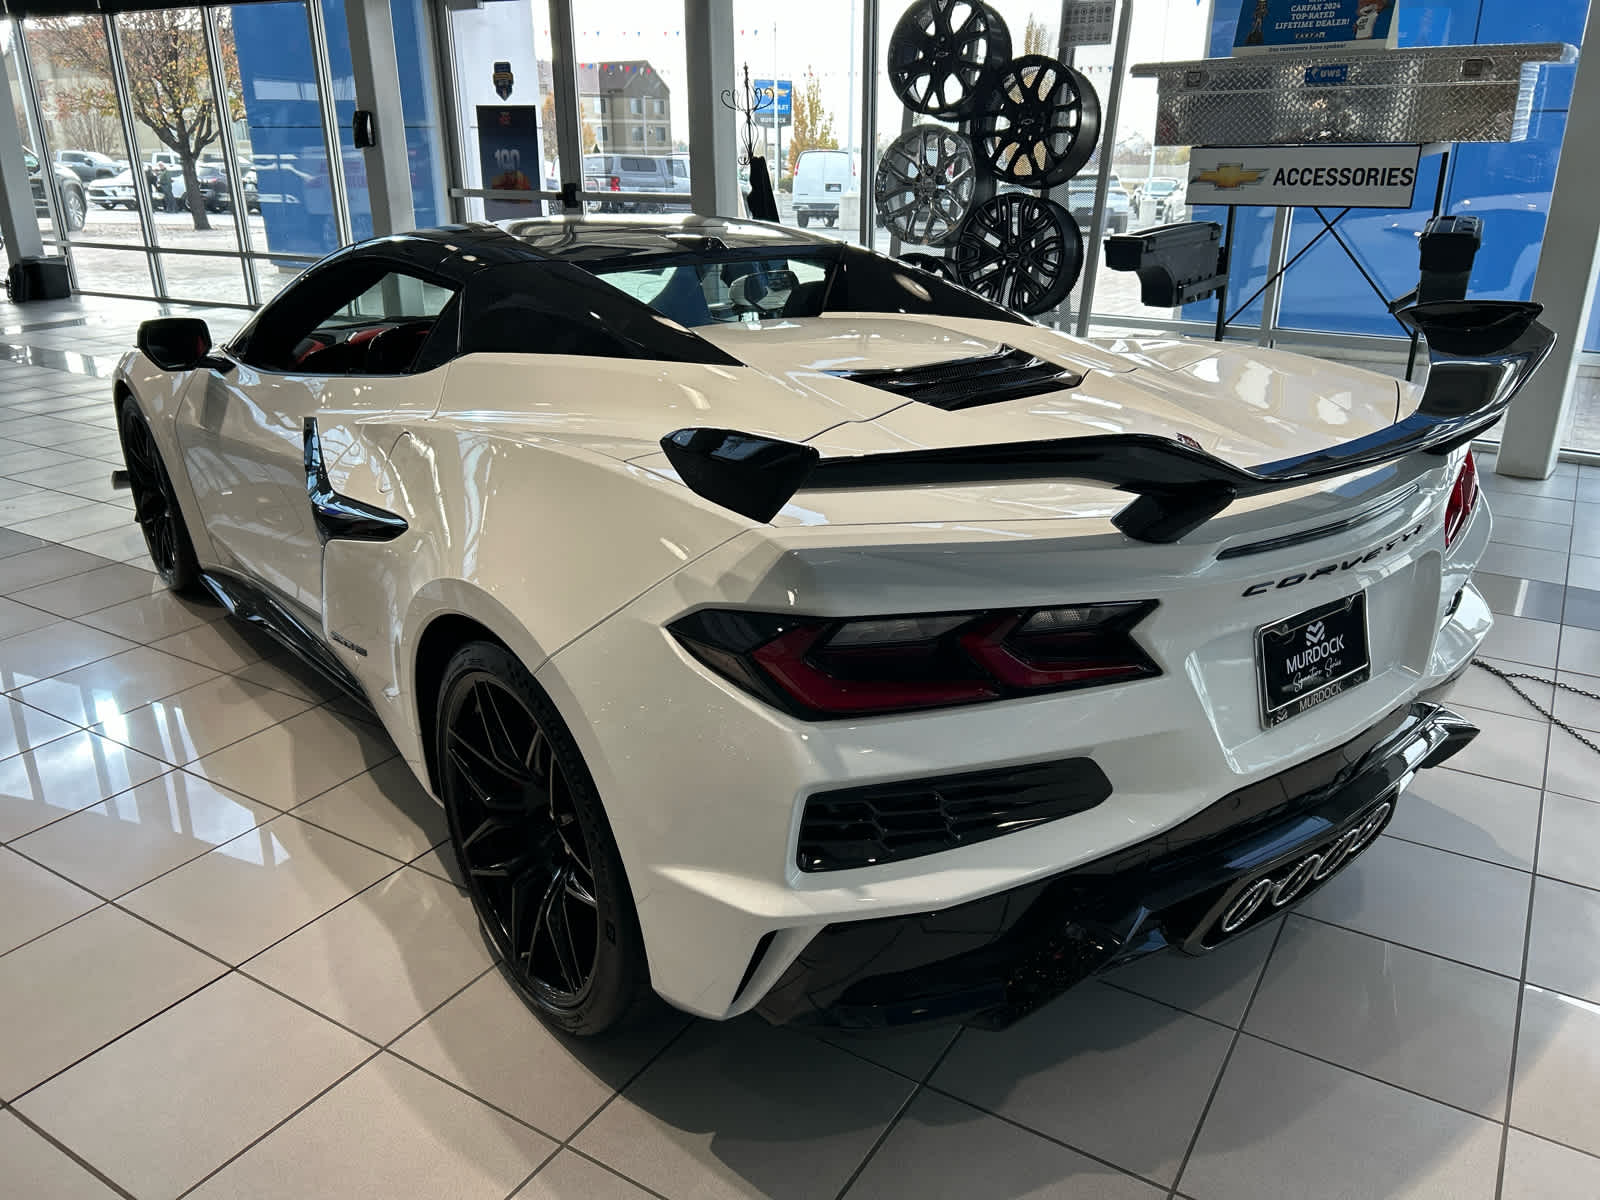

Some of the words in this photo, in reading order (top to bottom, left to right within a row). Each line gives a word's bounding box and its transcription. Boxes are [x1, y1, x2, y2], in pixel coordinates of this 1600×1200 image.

[1323, 2, 1341, 10] 2024
[1275, 22, 1313, 30] LIFETIME
[1315, 18, 1350, 27] DEALER!
[1273, 167, 1414, 187] ACCESSORIES
[1286, 633, 1345, 675] MURDOCK
[1299, 682, 1342, 712] MURDOCK
